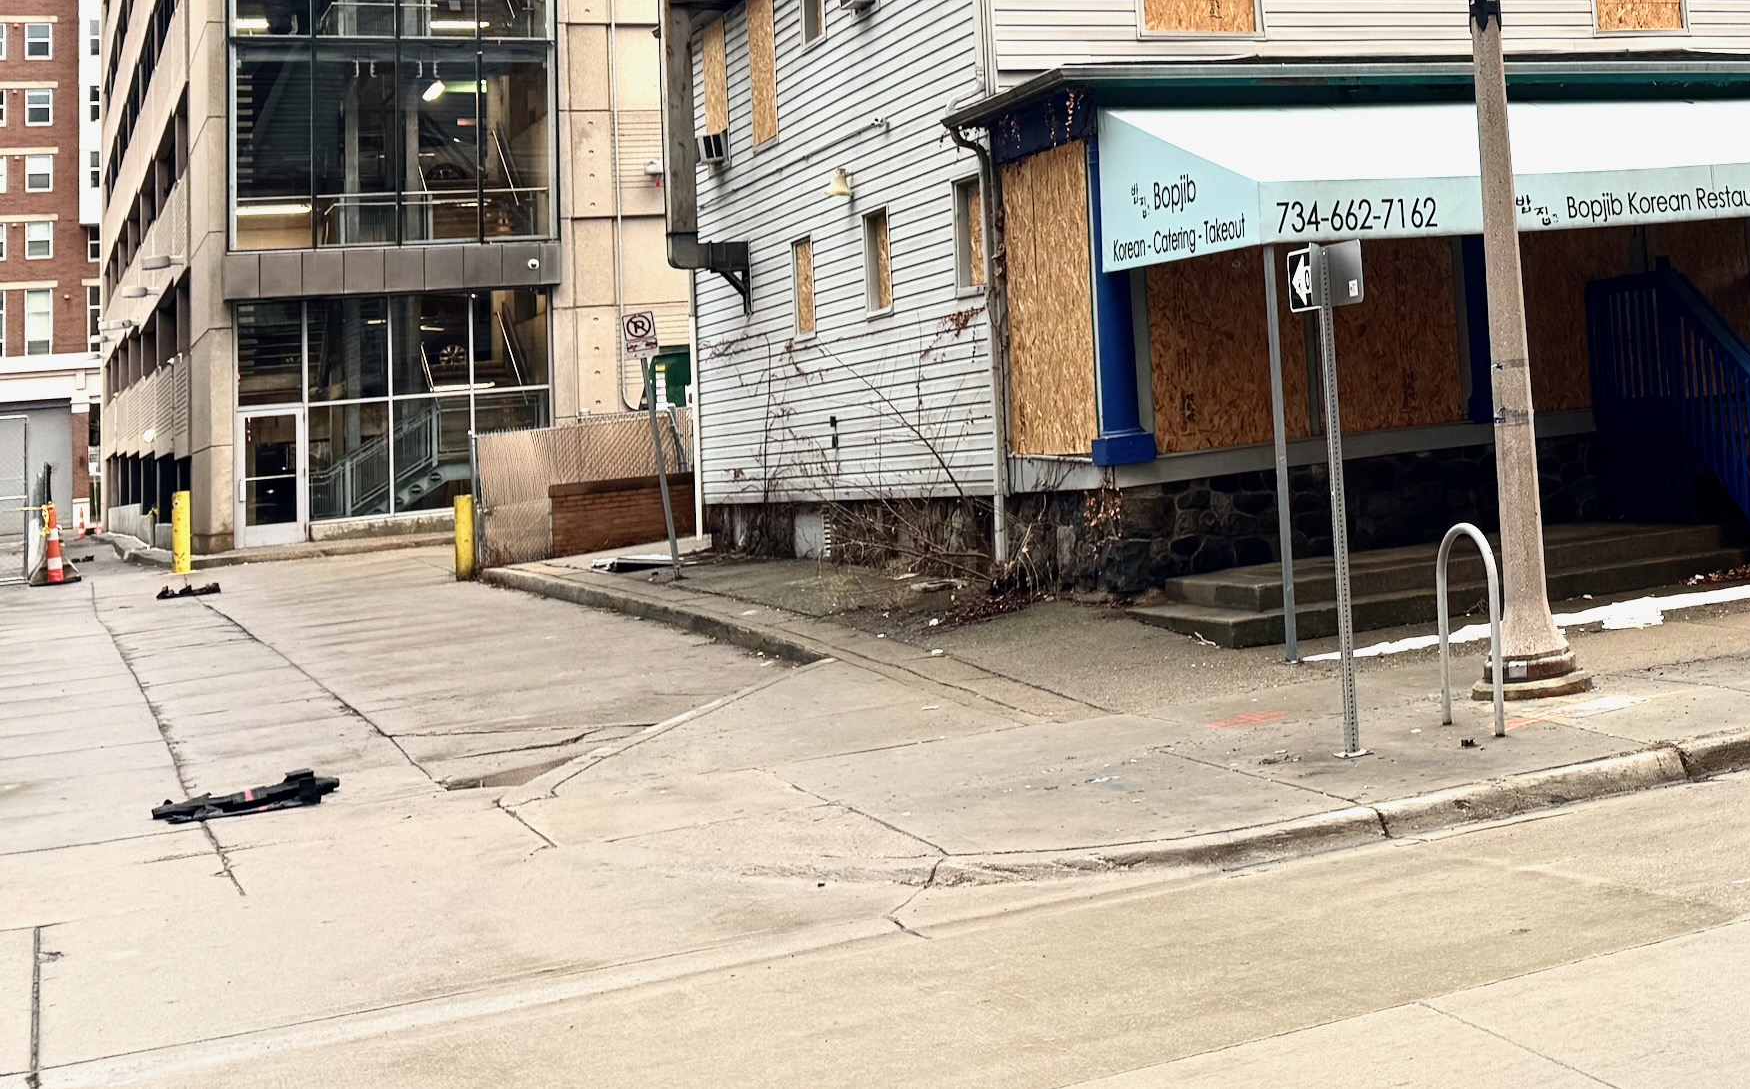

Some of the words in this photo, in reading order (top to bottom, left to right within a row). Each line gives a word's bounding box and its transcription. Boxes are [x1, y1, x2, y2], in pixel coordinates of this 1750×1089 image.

[1153, 173, 1197, 213] Bopjib
[1566, 192, 1623, 223] Bopjib
[1627, 191, 1692, 214] Korean
[1276, 196, 1438, 234] 734-662-7162
[1113, 239, 1146, 262] Korean
[1153, 226, 1196, 254] Catering
[1203, 212, 1245, 244] Takeout
